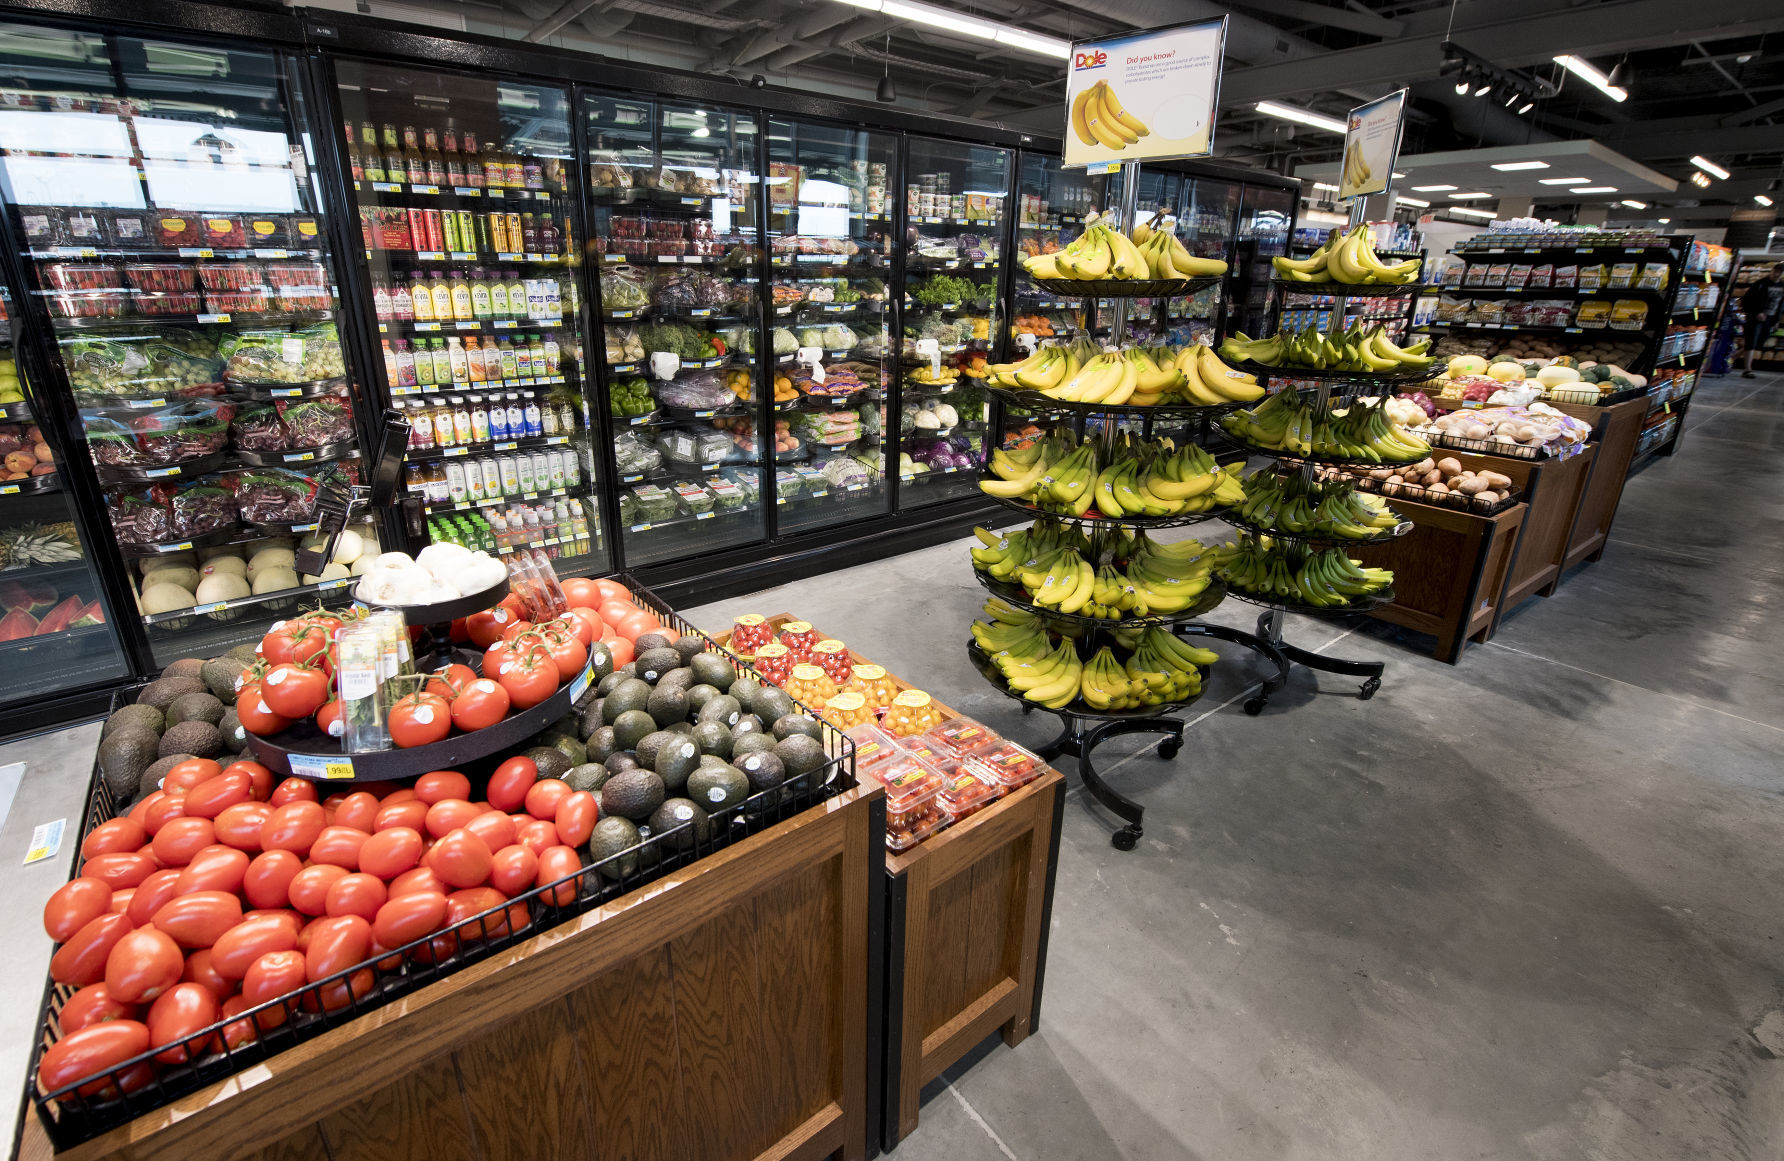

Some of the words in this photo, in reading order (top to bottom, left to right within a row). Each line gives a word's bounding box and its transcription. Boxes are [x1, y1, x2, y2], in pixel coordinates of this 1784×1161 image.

[1076, 50, 1107, 68] Dole
[1126, 56, 1138, 65] Did
[1139, 55, 1152, 64] you
[1153, 50, 1176, 61] know?
